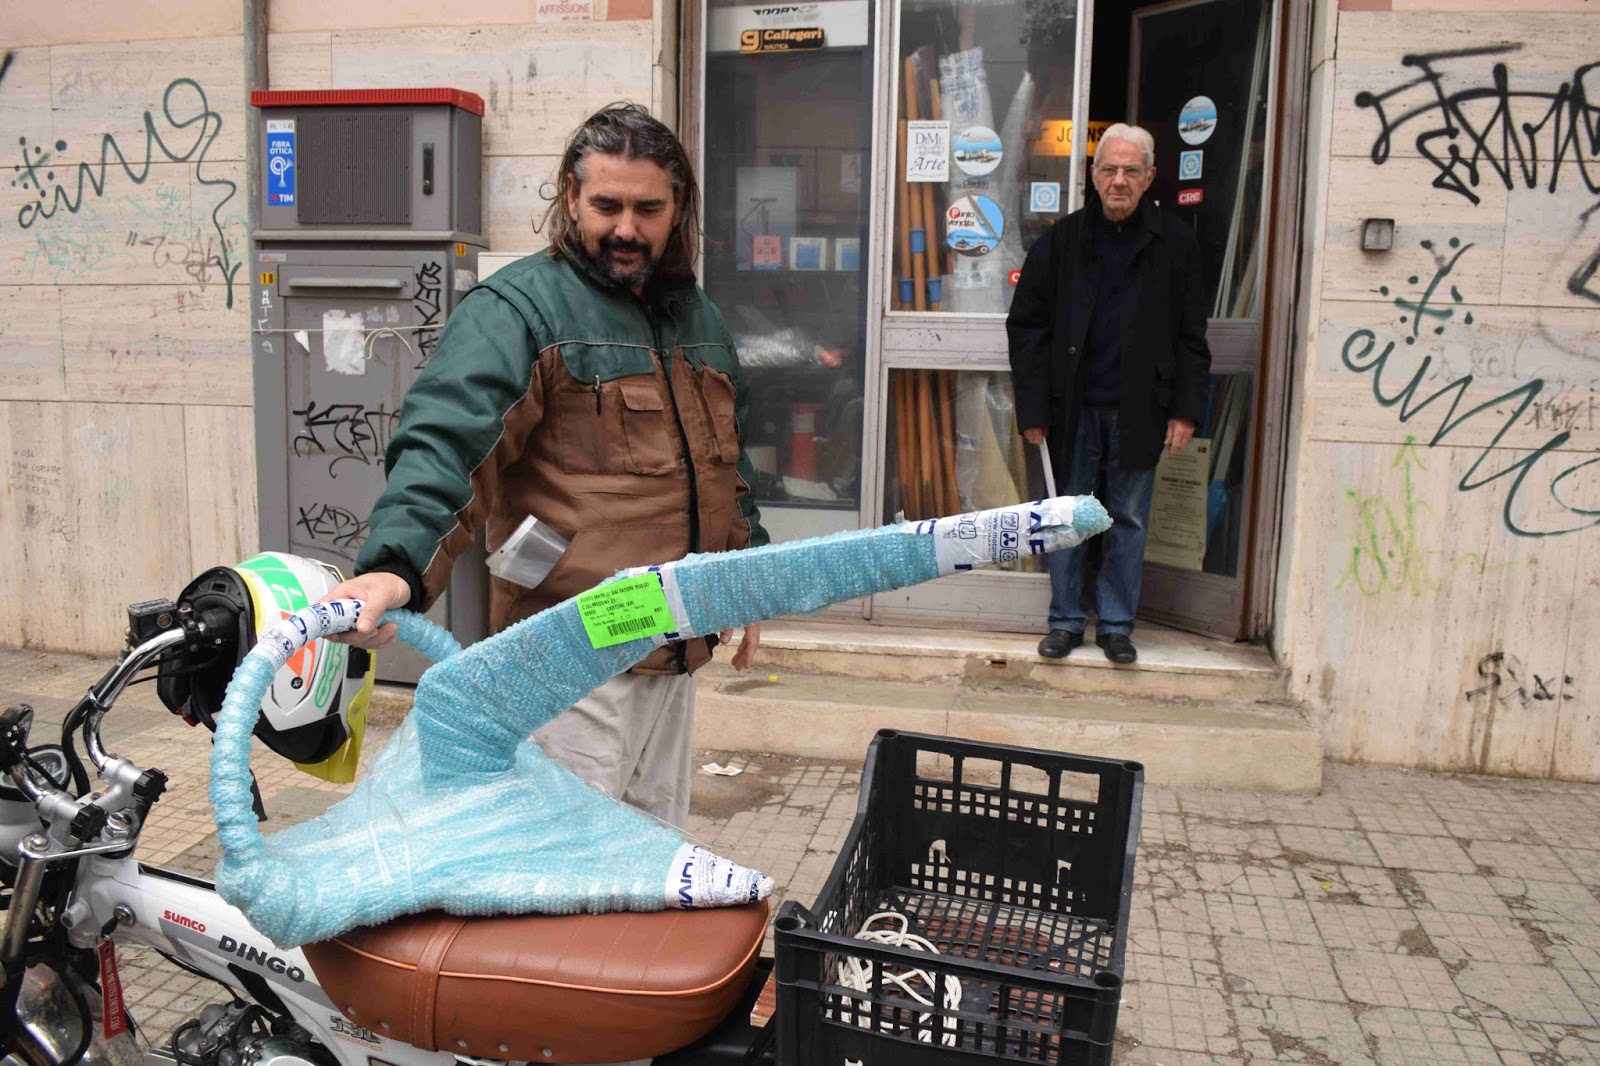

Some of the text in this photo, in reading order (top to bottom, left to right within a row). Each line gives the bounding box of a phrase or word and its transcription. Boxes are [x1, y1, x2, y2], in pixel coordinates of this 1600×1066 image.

[539, 3, 591, 14] AFFISSIONE
[764, 29, 822, 42] Callegari
[279, 194, 294, 202] TIM
[1179, 192, 1201, 203] CRC
[261, 273, 275, 284] 18
[217, 934, 306, 983] DINGO
